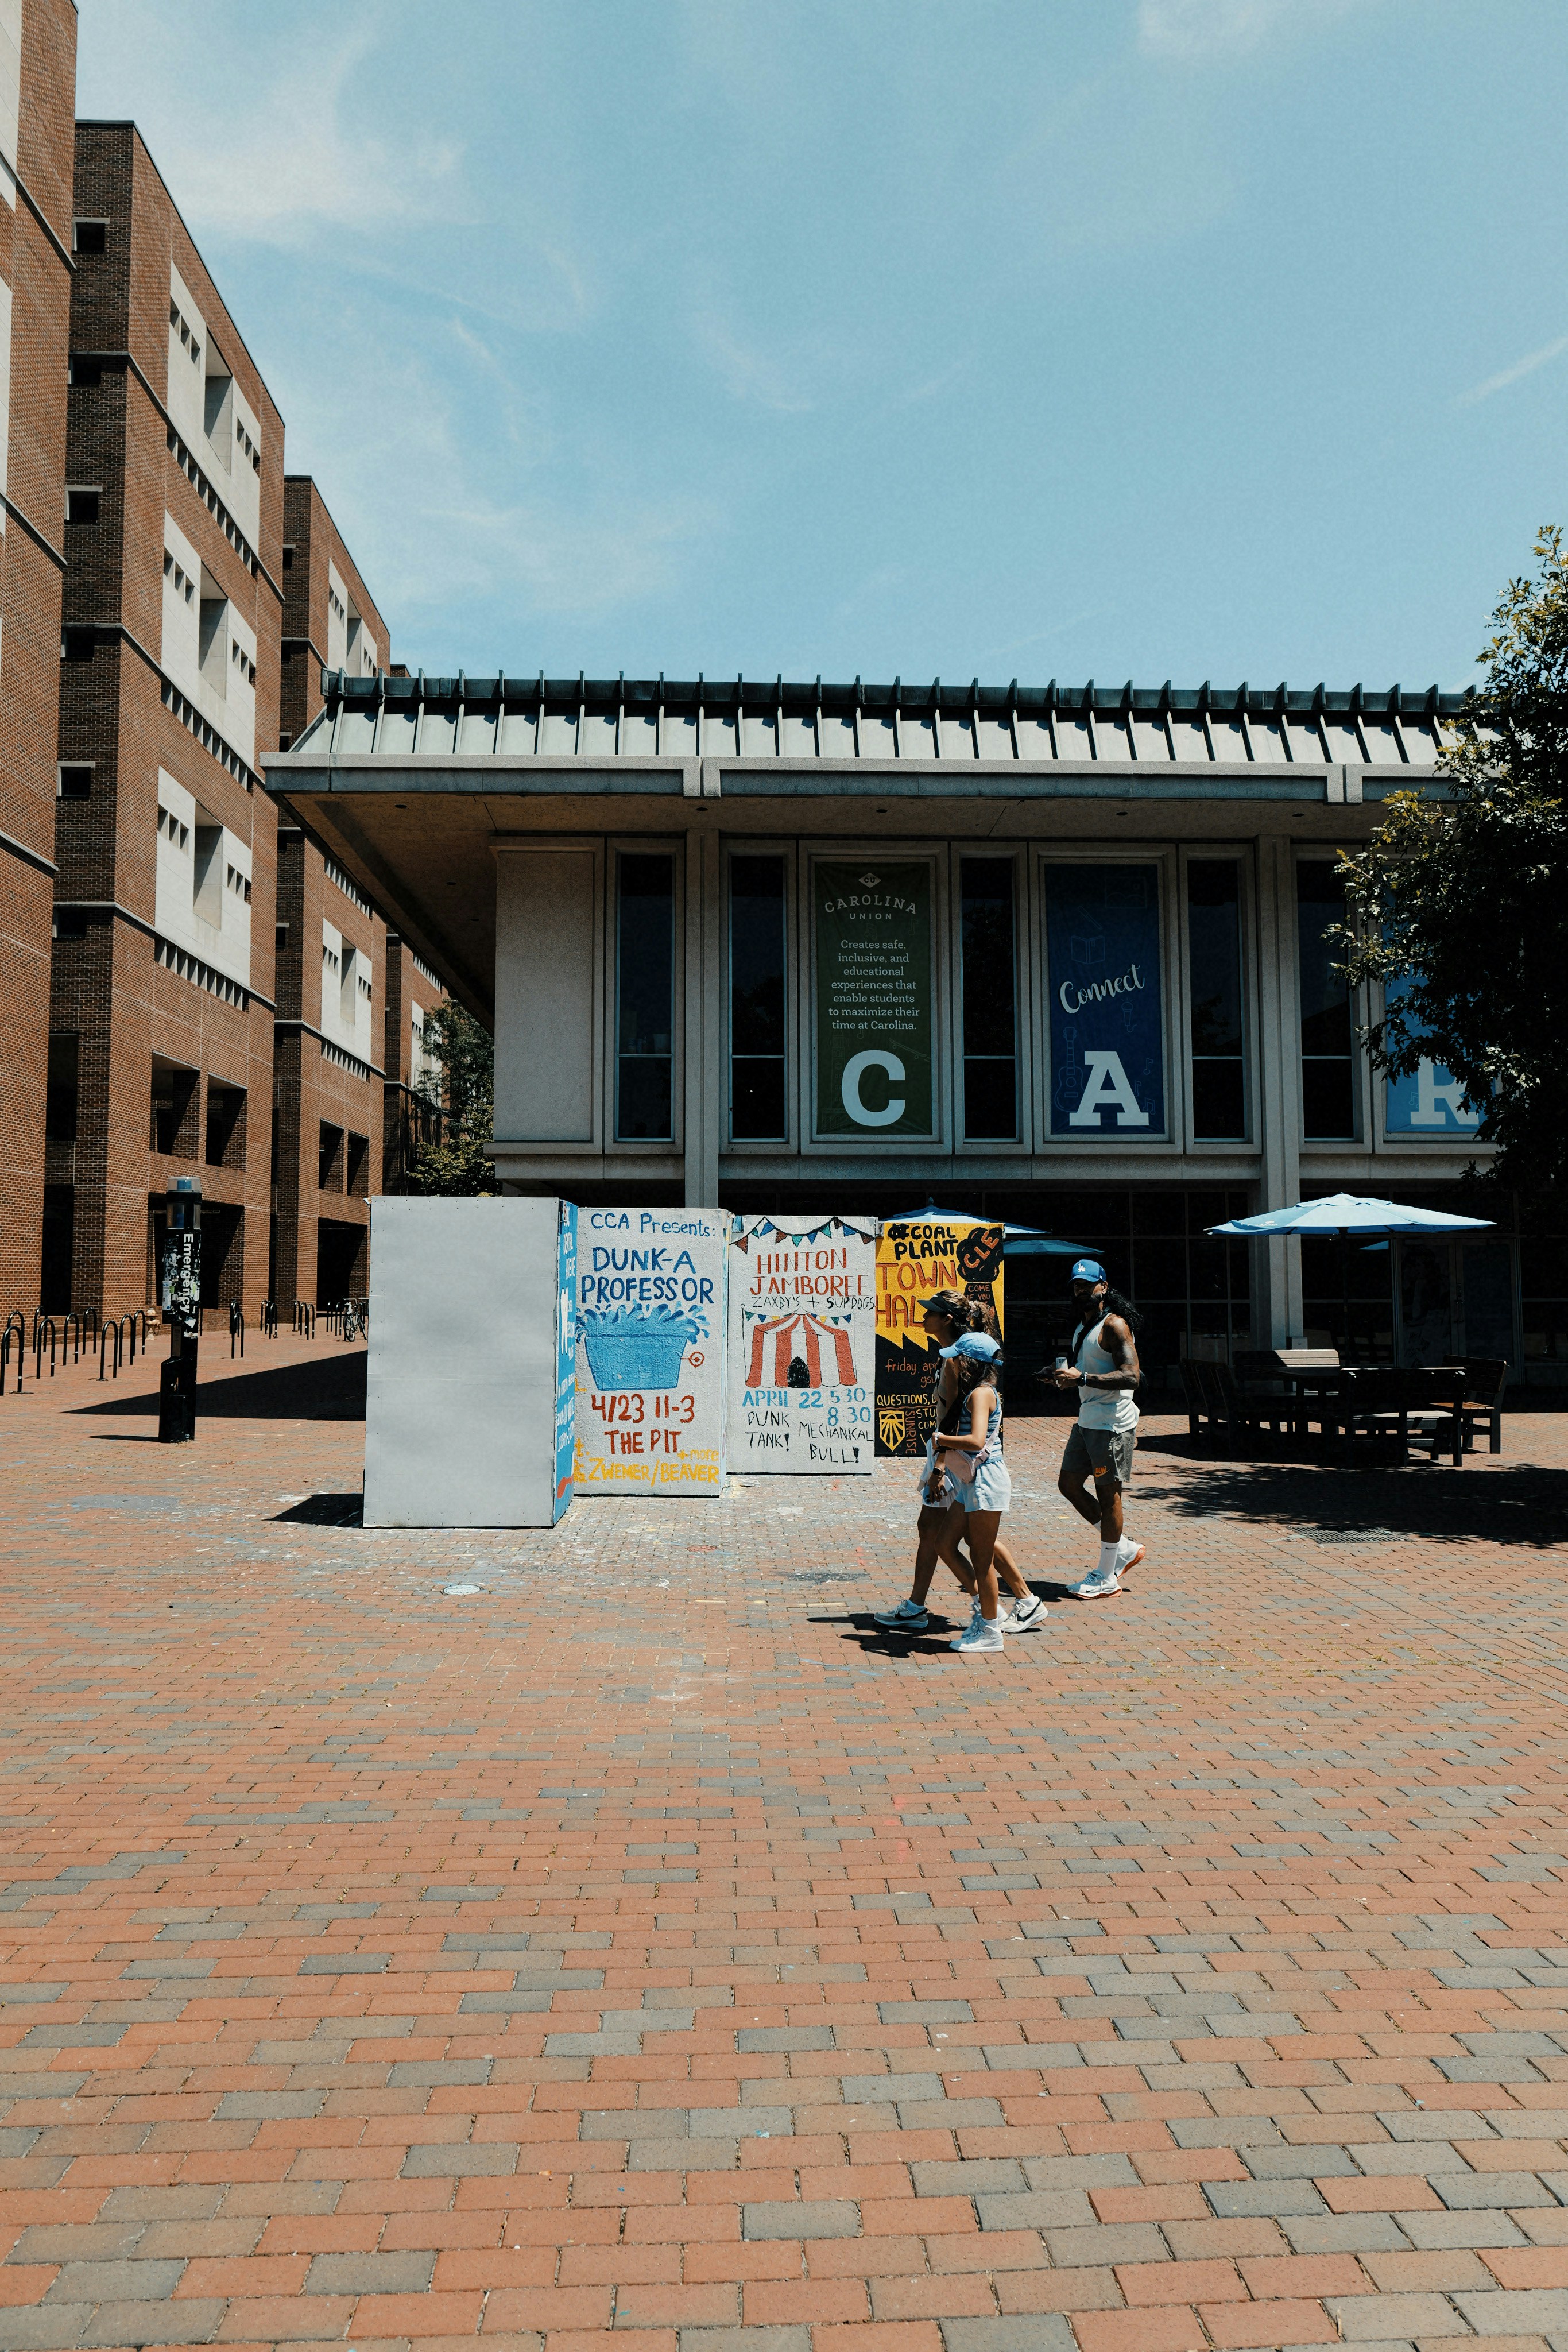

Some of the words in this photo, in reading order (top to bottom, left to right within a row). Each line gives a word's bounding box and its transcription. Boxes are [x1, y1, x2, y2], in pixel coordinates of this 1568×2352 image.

[825, 895, 916, 914] CAROLINA
[841, 939, 880, 949] Creates
[882, 939, 906, 950] safe,
[838, 953, 888, 963] inclusive,
[890, 953, 909, 962] and
[843, 966, 904, 976] educational
[831, 980, 893, 992] experiences
[896, 980, 917, 989] that
[1060, 964, 1145, 1014] Connect
[833, 993, 868, 1003] enable
[870, 993, 915, 1003] students
[841, 1007, 893, 1016] maximize
[895, 1007, 920, 1016] their
[832, 1020, 855, 1030] time
[870, 1020, 916, 1030] Carolina.
[841, 1050, 906, 1127] C
[1069, 1051, 1150, 1126] A
[591, 1213, 629, 1229] CCA
[640, 1213, 715, 1237] Presents:
[911, 1225, 956, 1240] COAL
[894, 1239, 958, 1261] PLANT
[593, 1247, 696, 1274] DUNK-A
[757, 1248, 847, 1274] HINTON
[1078, 1263, 1086, 1272] LA
[180, 1233, 194, 1314] Emergency
[876, 1260, 958, 1291] TOWN
[581, 1275, 714, 1304] PROFESSOR
[750, 1275, 868, 1297] JAMBOREE
[968, 1284, 991, 1293] COME
[752, 1294, 800, 1309] ZAXBY'S
[875, 1294, 925, 1328] HAL
[591, 1394, 645, 1423] 4/23
[742, 1390, 793, 1407] APRIL
[799, 1390, 824, 1409] 22
[877, 1394, 930, 1406] QUESTIONS,
[748, 1410, 789, 1427] DUNK
[799, 1421, 874, 1442] MECHANICAL
[905, 1410, 917, 1454] SUNRISE
[604, 1429, 644, 1455] THE
[650, 1429, 682, 1454] PIT
[745, 1432, 789, 1452] TANK!
[690, 1449, 719, 1461] more
[810, 1443, 859, 1463] BULL!
